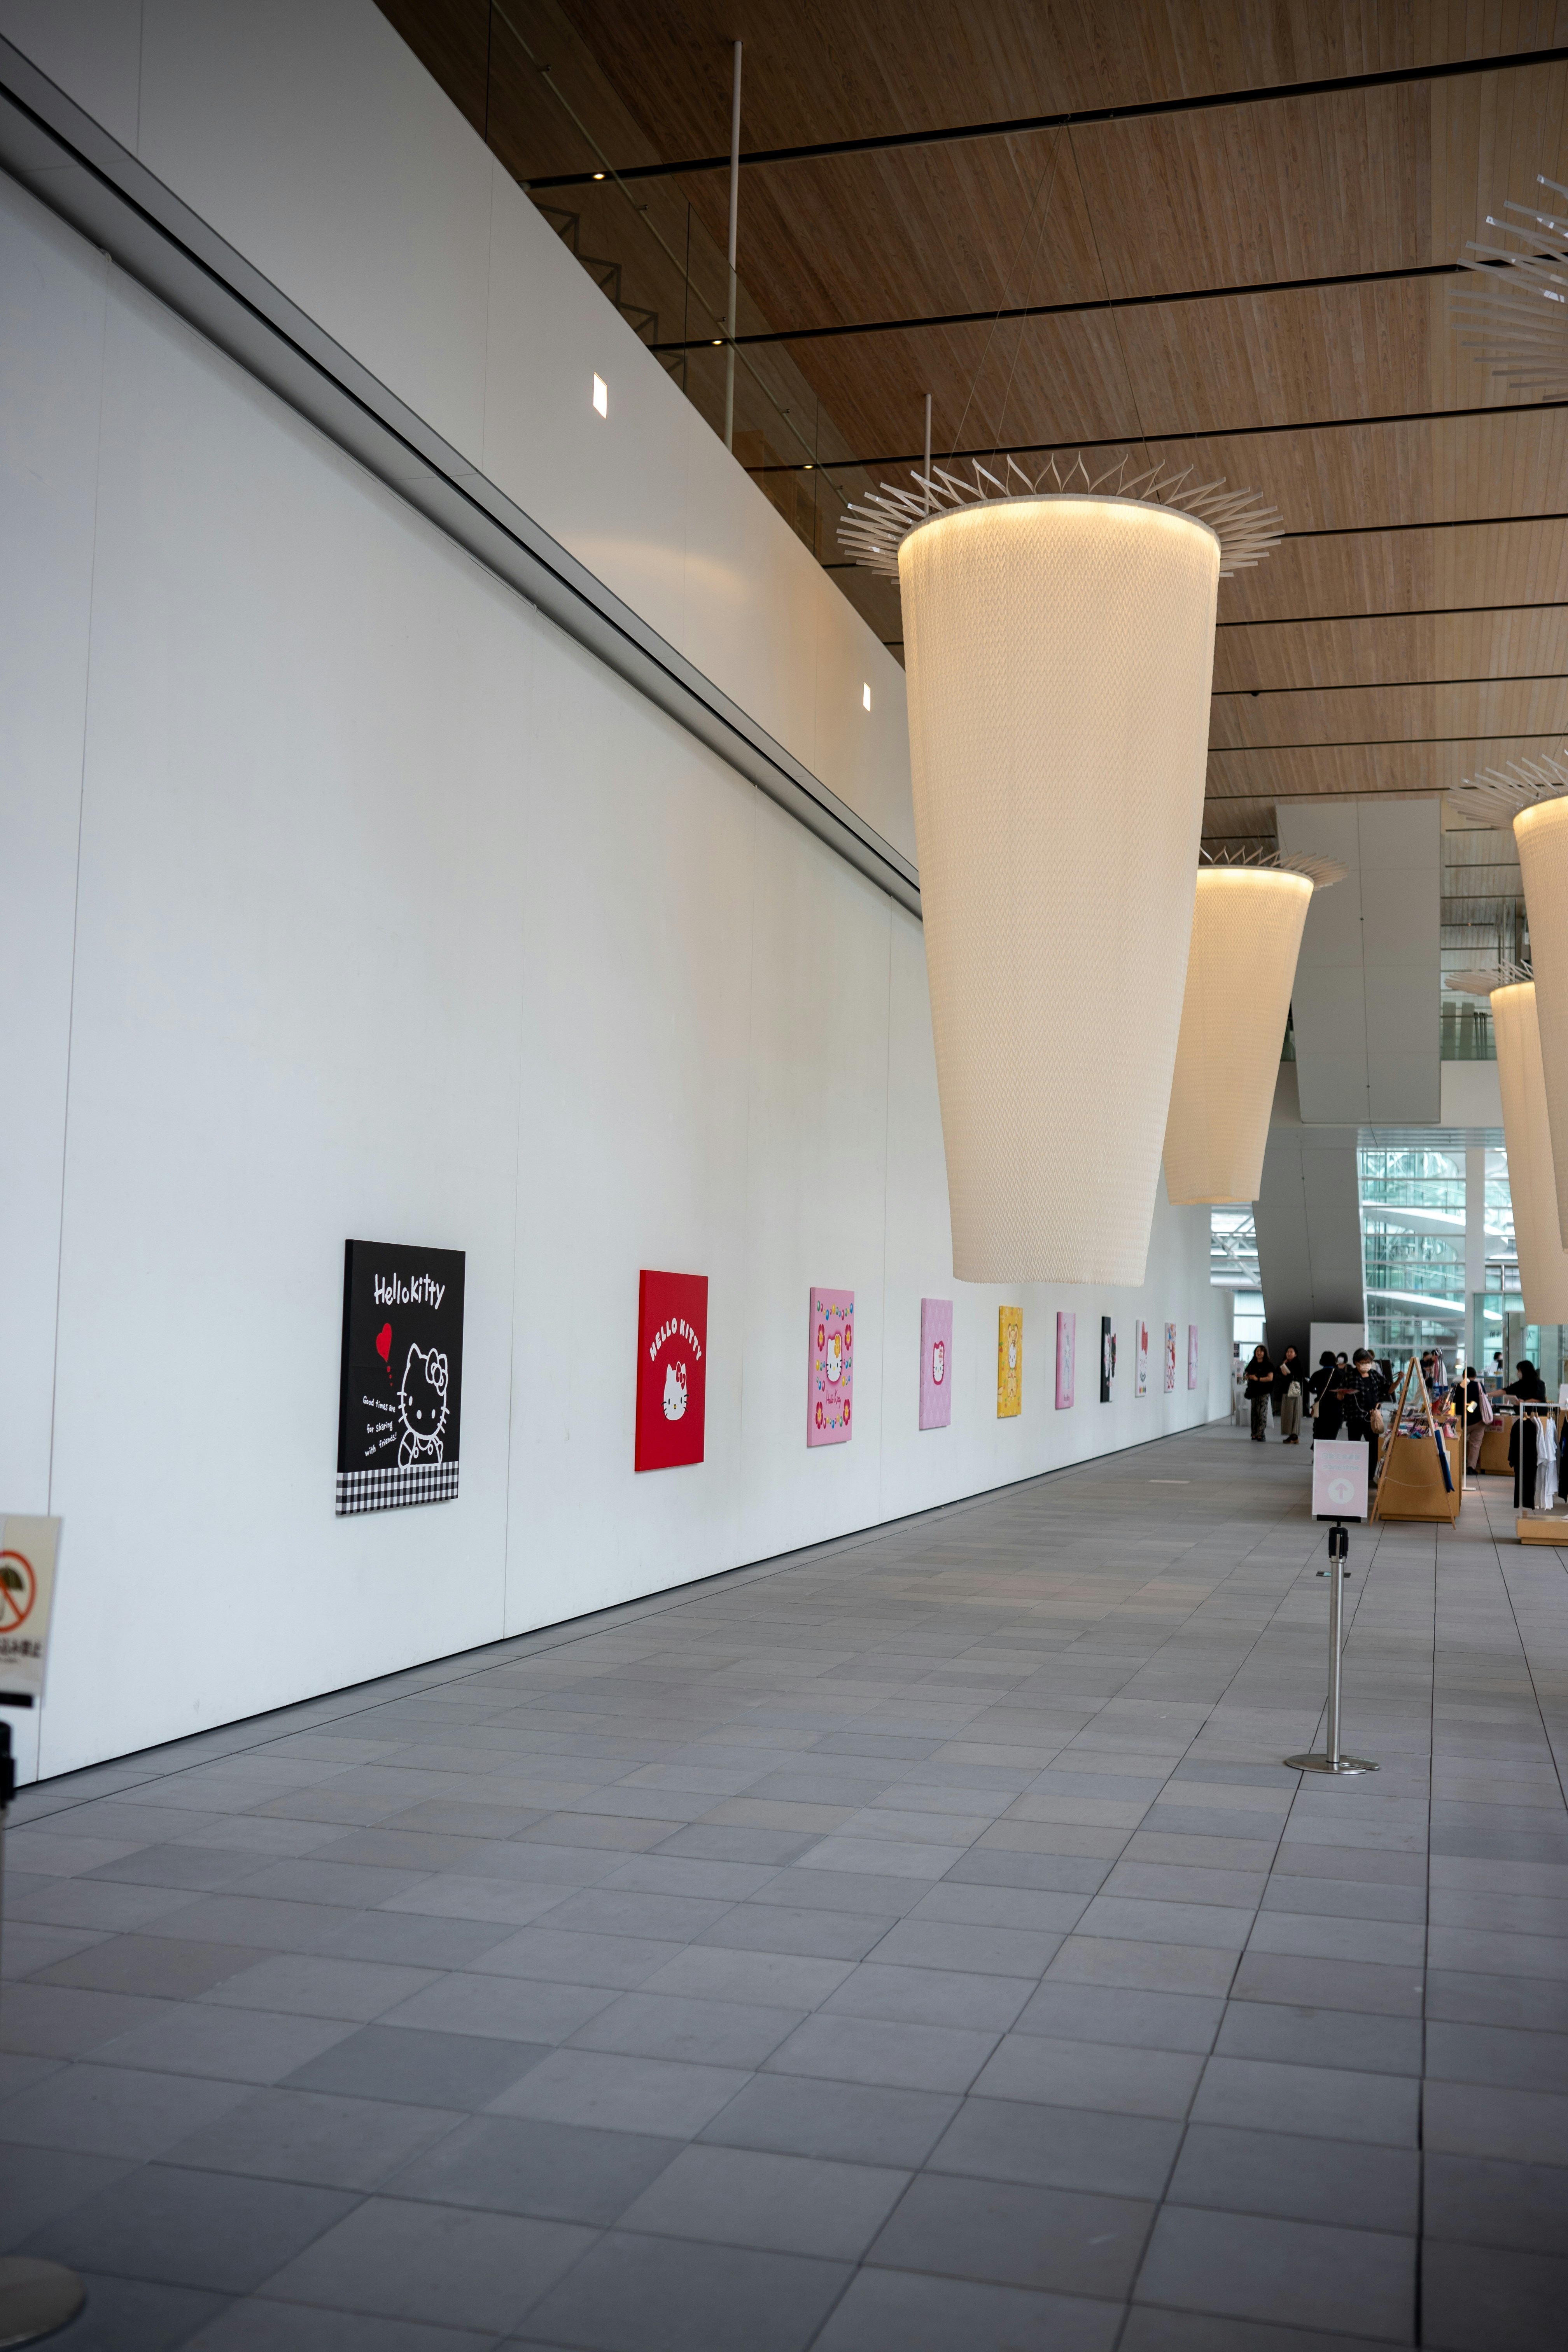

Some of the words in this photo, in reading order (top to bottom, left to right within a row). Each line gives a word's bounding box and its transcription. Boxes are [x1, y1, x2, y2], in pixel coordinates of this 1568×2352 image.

[650, 1318, 677, 1361] HELLO
[680, 1319, 702, 1361] KITTY
[363, 1395, 374, 1406] Good
[376, 1400, 388, 1411] times
[376, 1421, 393, 1432] sharing
[365, 1444, 376, 1456] with
[379, 1432, 397, 1448] friends!
